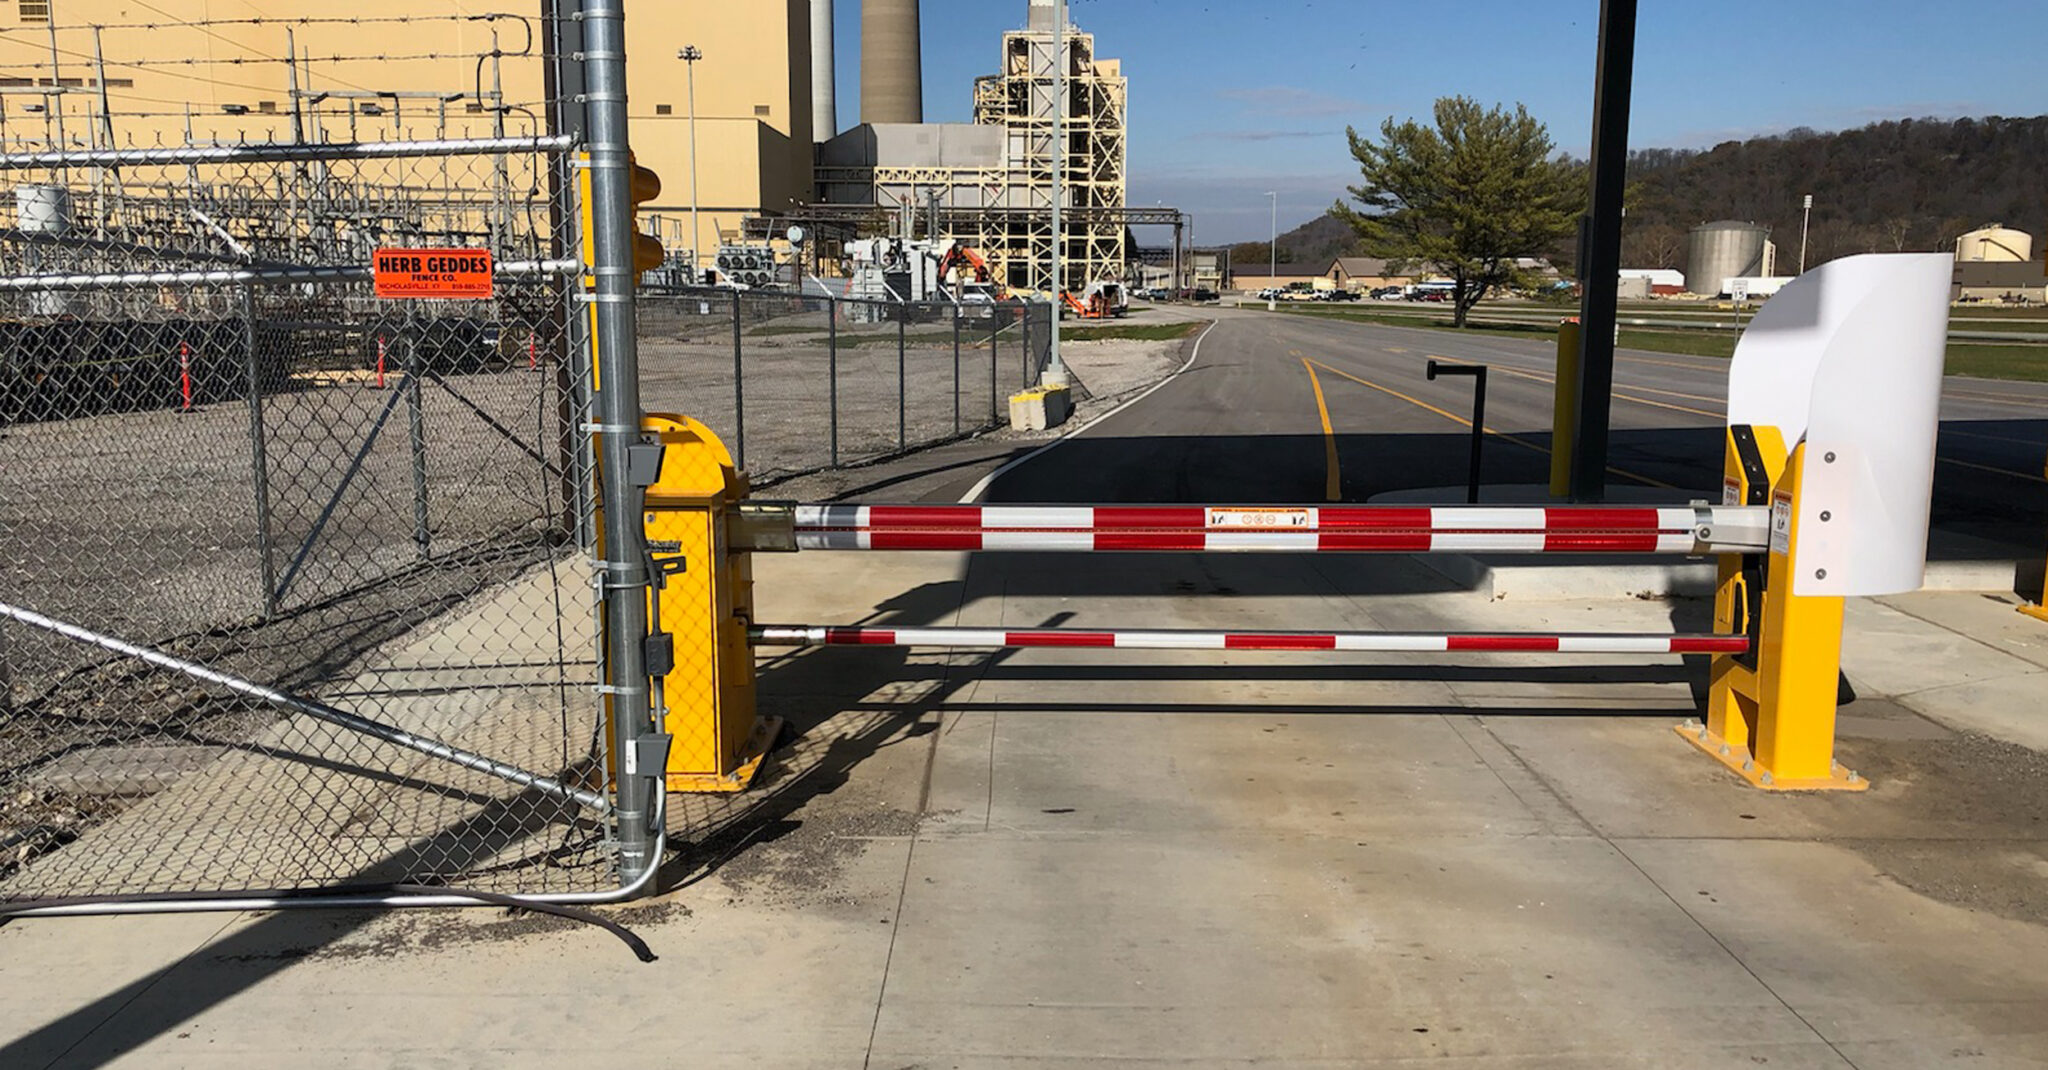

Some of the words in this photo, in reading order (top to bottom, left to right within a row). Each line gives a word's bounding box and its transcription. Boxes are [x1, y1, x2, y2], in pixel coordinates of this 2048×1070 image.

[379, 257, 421, 273] HERB
[427, 257, 487, 273] GEDDES
[411, 274, 439, 282] FENCE
